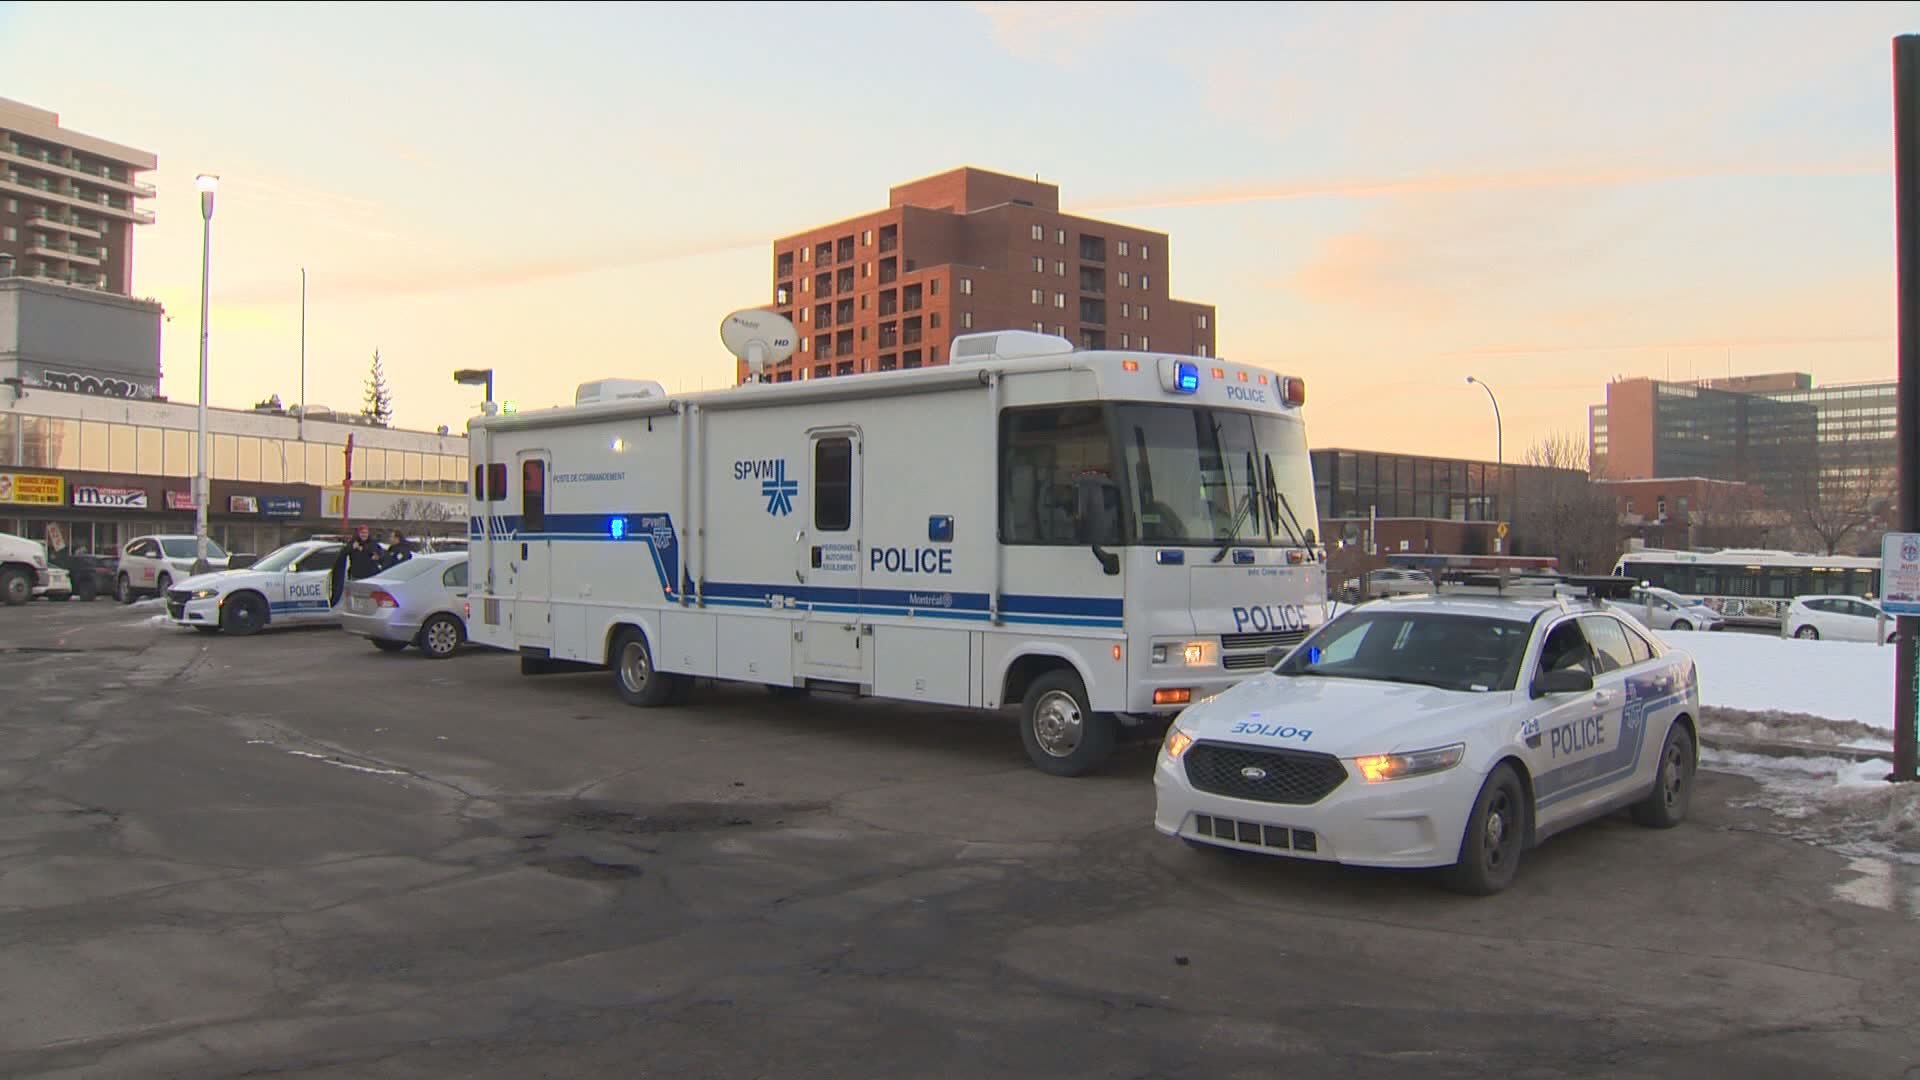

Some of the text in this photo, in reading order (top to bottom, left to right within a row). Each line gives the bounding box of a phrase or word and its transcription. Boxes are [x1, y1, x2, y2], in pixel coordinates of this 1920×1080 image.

[774, 338, 790, 347] HD
[1226, 385, 1265, 403] POLICE
[734, 459, 774, 480] SPVM
[871, 547, 953, 574] POLICE
[289, 583, 321, 597] POLICE
[1232, 604, 1310, 633] POLICE
[1552, 714, 1605, 759] POLICE
